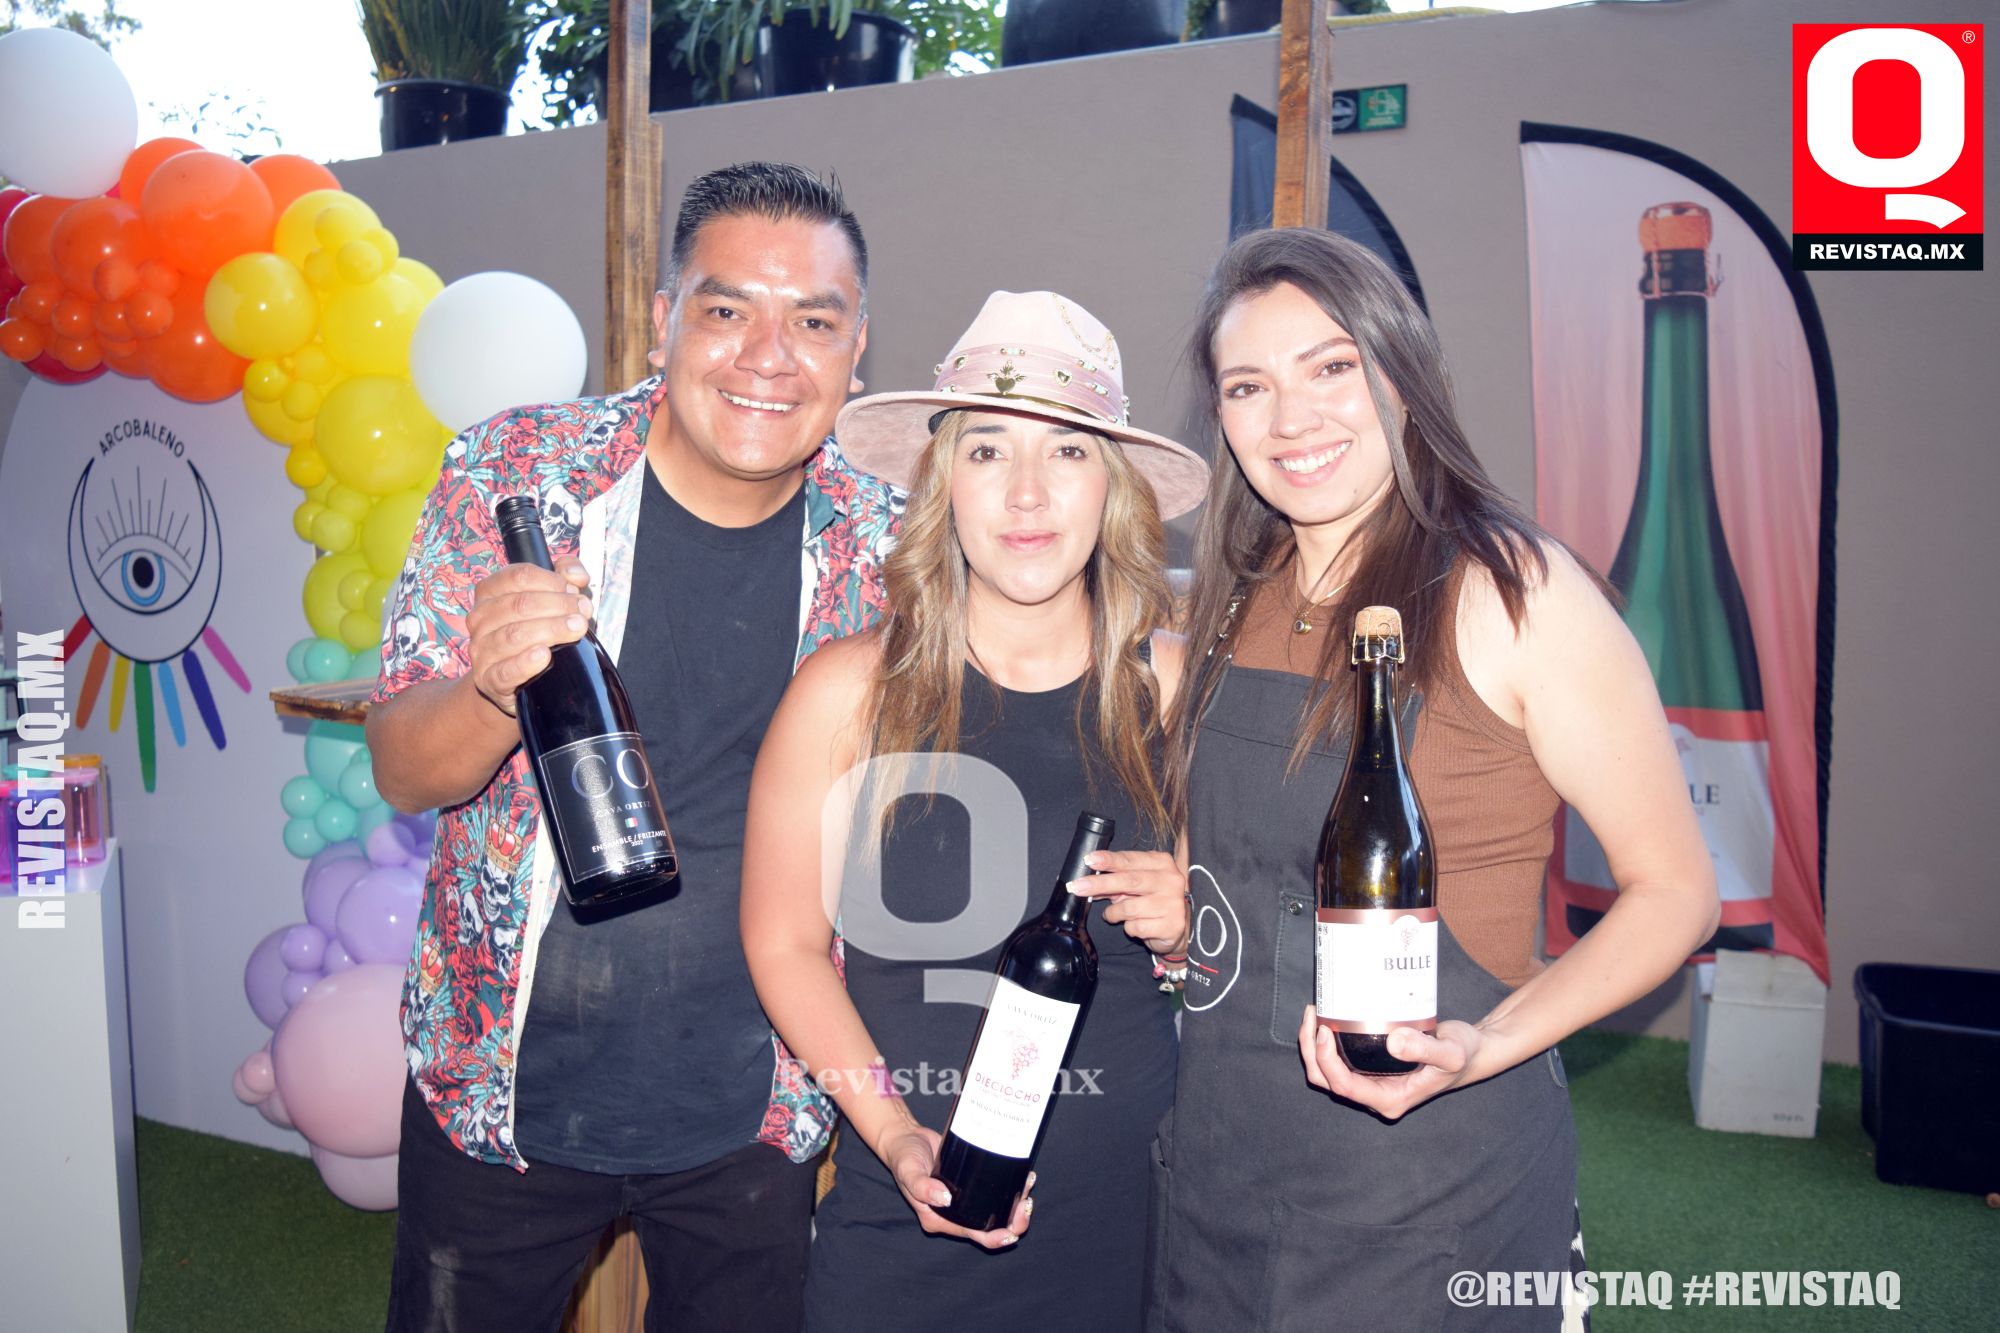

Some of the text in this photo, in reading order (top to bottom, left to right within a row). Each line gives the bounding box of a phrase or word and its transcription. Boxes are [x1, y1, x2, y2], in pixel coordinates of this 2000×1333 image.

[99, 418, 185, 458] ARCOBALENO
[592, 836, 632, 852] ENSAMBLE
[1383, 955, 1431, 971] BULLE
[974, 1072, 1041, 1104] DIECIOCHO
